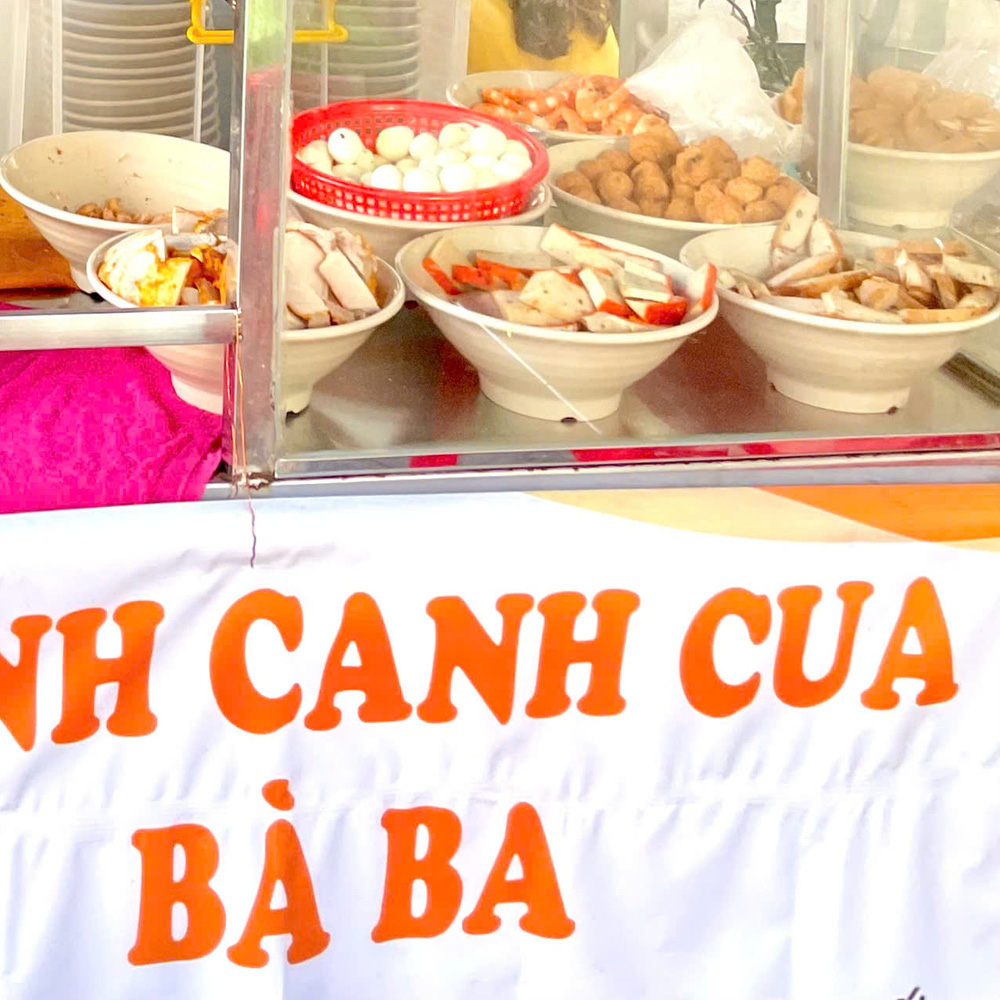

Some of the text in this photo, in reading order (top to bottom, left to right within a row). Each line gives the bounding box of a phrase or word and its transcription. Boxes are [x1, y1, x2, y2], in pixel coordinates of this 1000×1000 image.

[209, 587, 641, 735] CANH
[678, 576, 960, 719] CUA
[126, 777, 577, 970] BÀ BA
